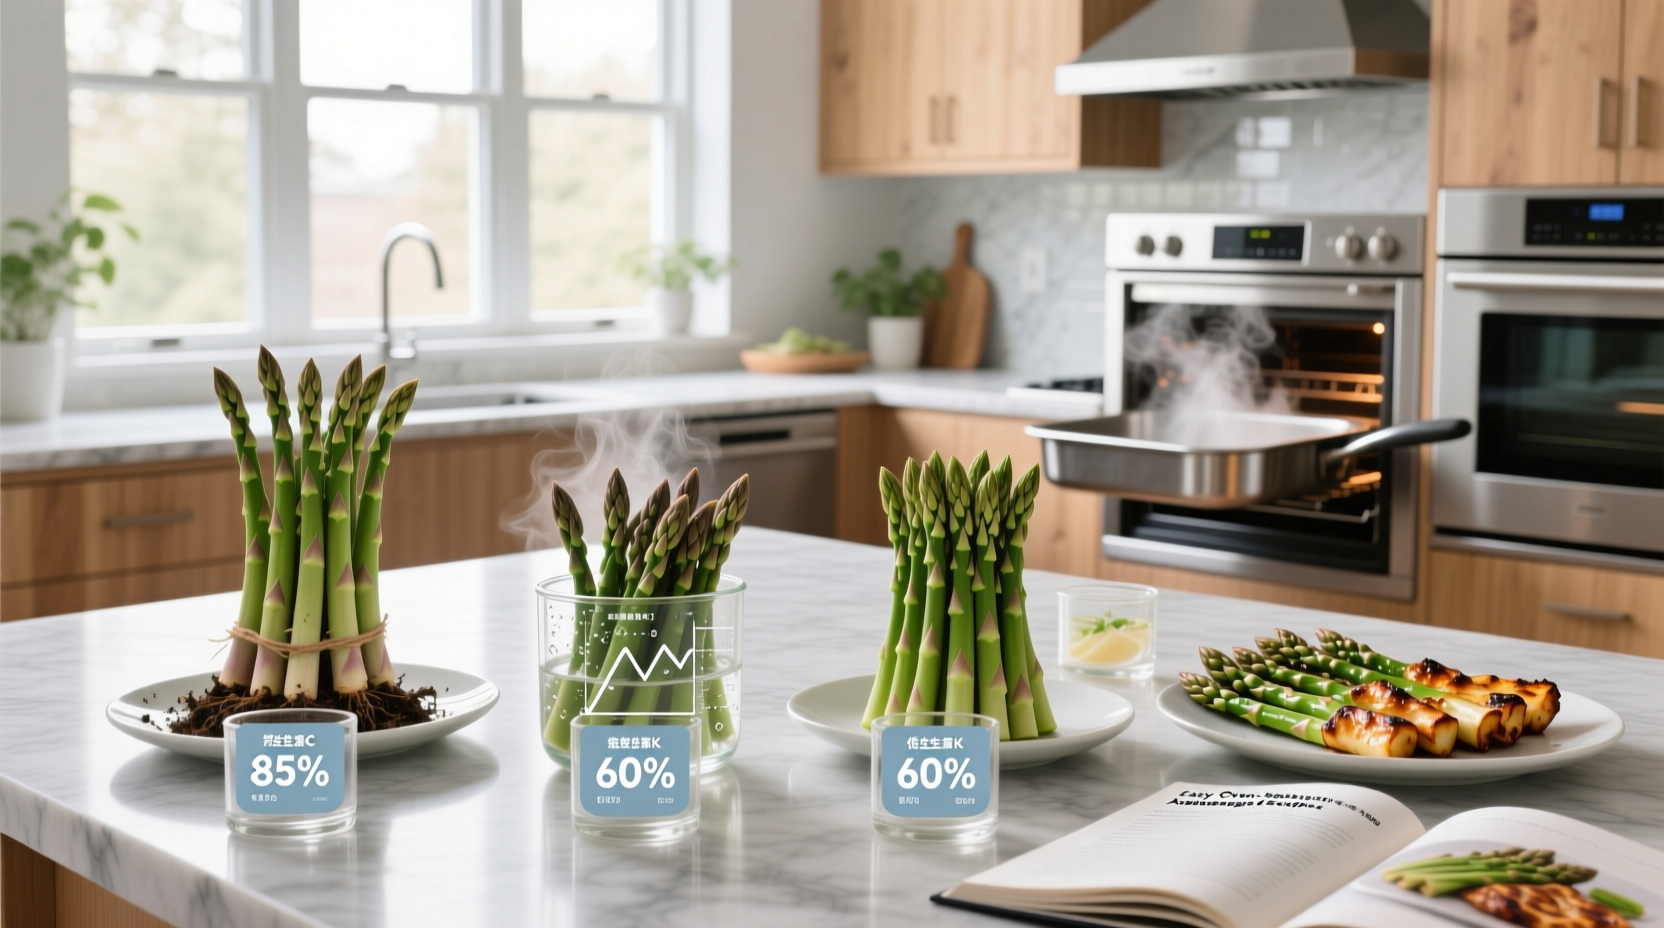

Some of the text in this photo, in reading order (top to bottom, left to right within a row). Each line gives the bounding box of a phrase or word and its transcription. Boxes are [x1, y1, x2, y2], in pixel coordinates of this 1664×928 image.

[250, 754, 330, 787] 85%
[596, 756, 676, 789] 60%
[897, 757, 976, 790] 60%
